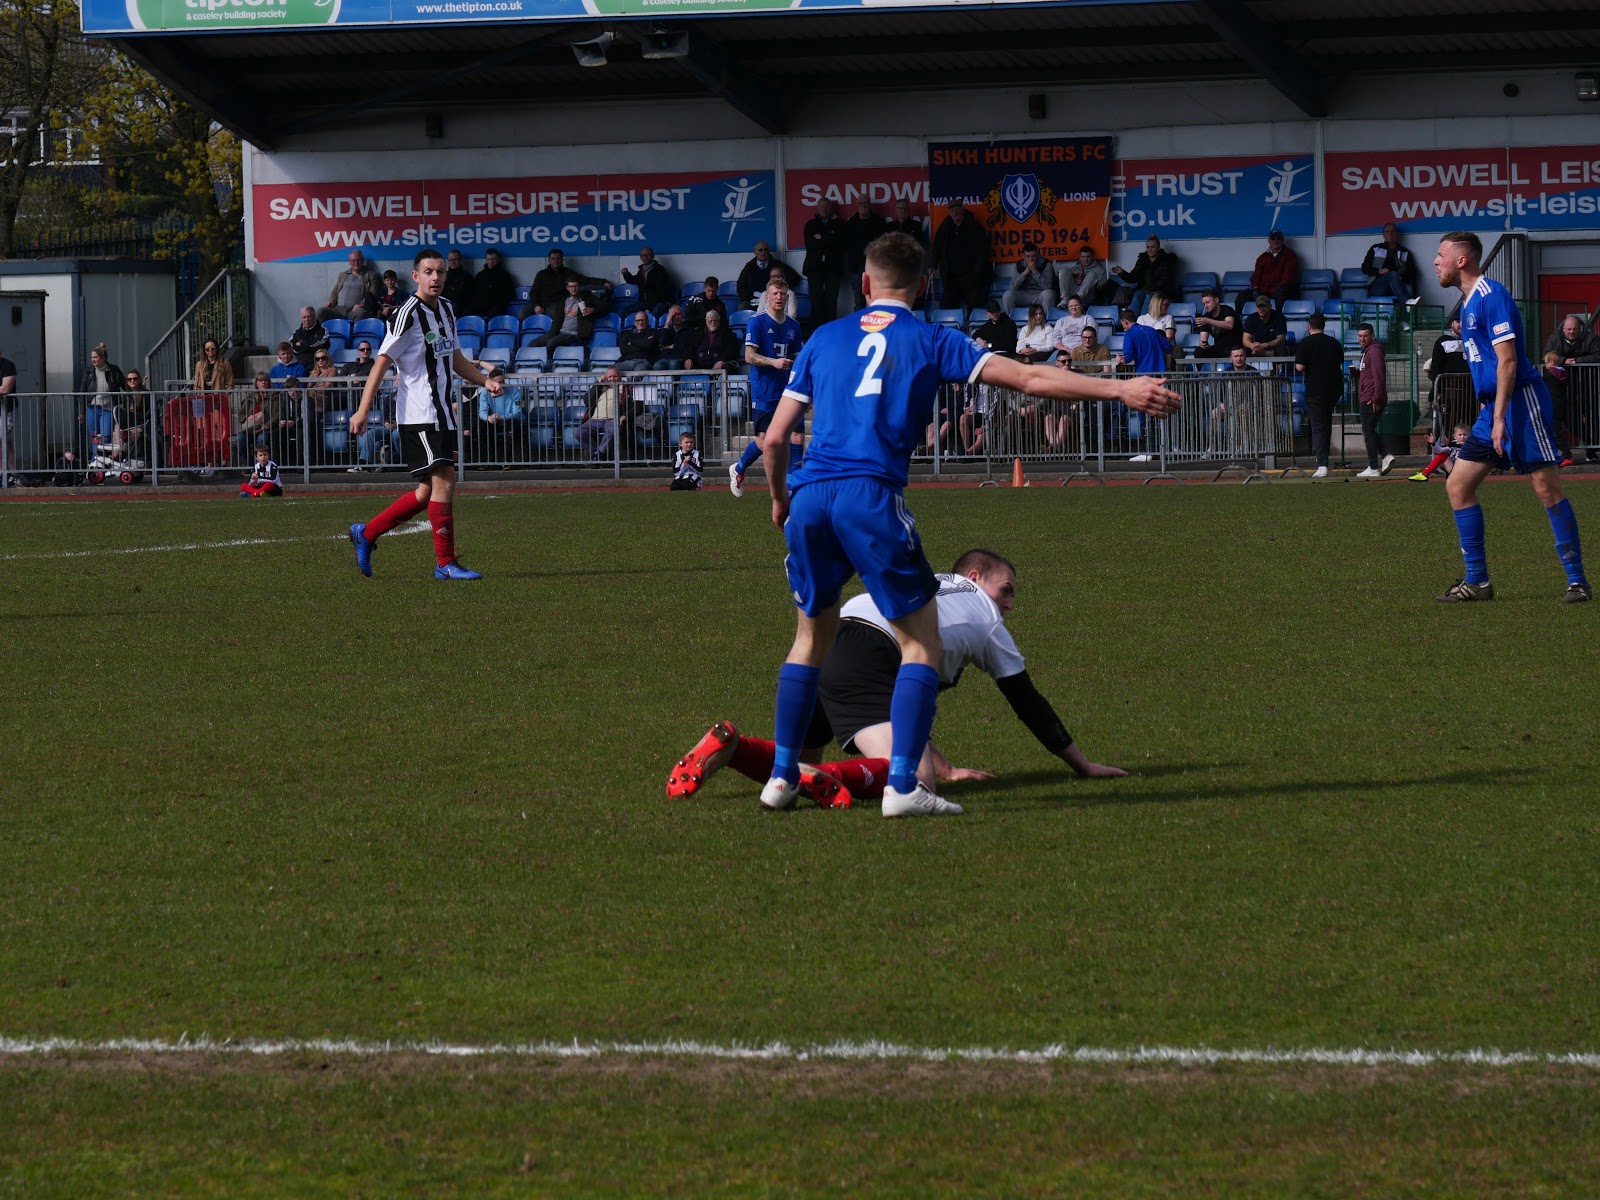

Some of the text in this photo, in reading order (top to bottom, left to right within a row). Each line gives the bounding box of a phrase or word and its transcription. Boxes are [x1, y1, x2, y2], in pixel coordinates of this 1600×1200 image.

[193, 12, 223, 20] coseley
[224, 11, 256, 20] building
[257, 10, 287, 18] society
[416, 1, 523, 13] www.thetipton.co.uk
[932, 143, 1106, 166] SIKH HUNTERS FC
[1135, 172, 1243, 197] TRUST
[1341, 163, 1530, 190] SANDWELL
[269, 188, 691, 220] SANDWELL LEISURE TRUST
[1063, 191, 1097, 203] LIONS
[315, 218, 647, 247] www.slt-leisure.co.uk
[1052, 228, 1090, 243] 1964
[854, 332, 887, 398] 2
